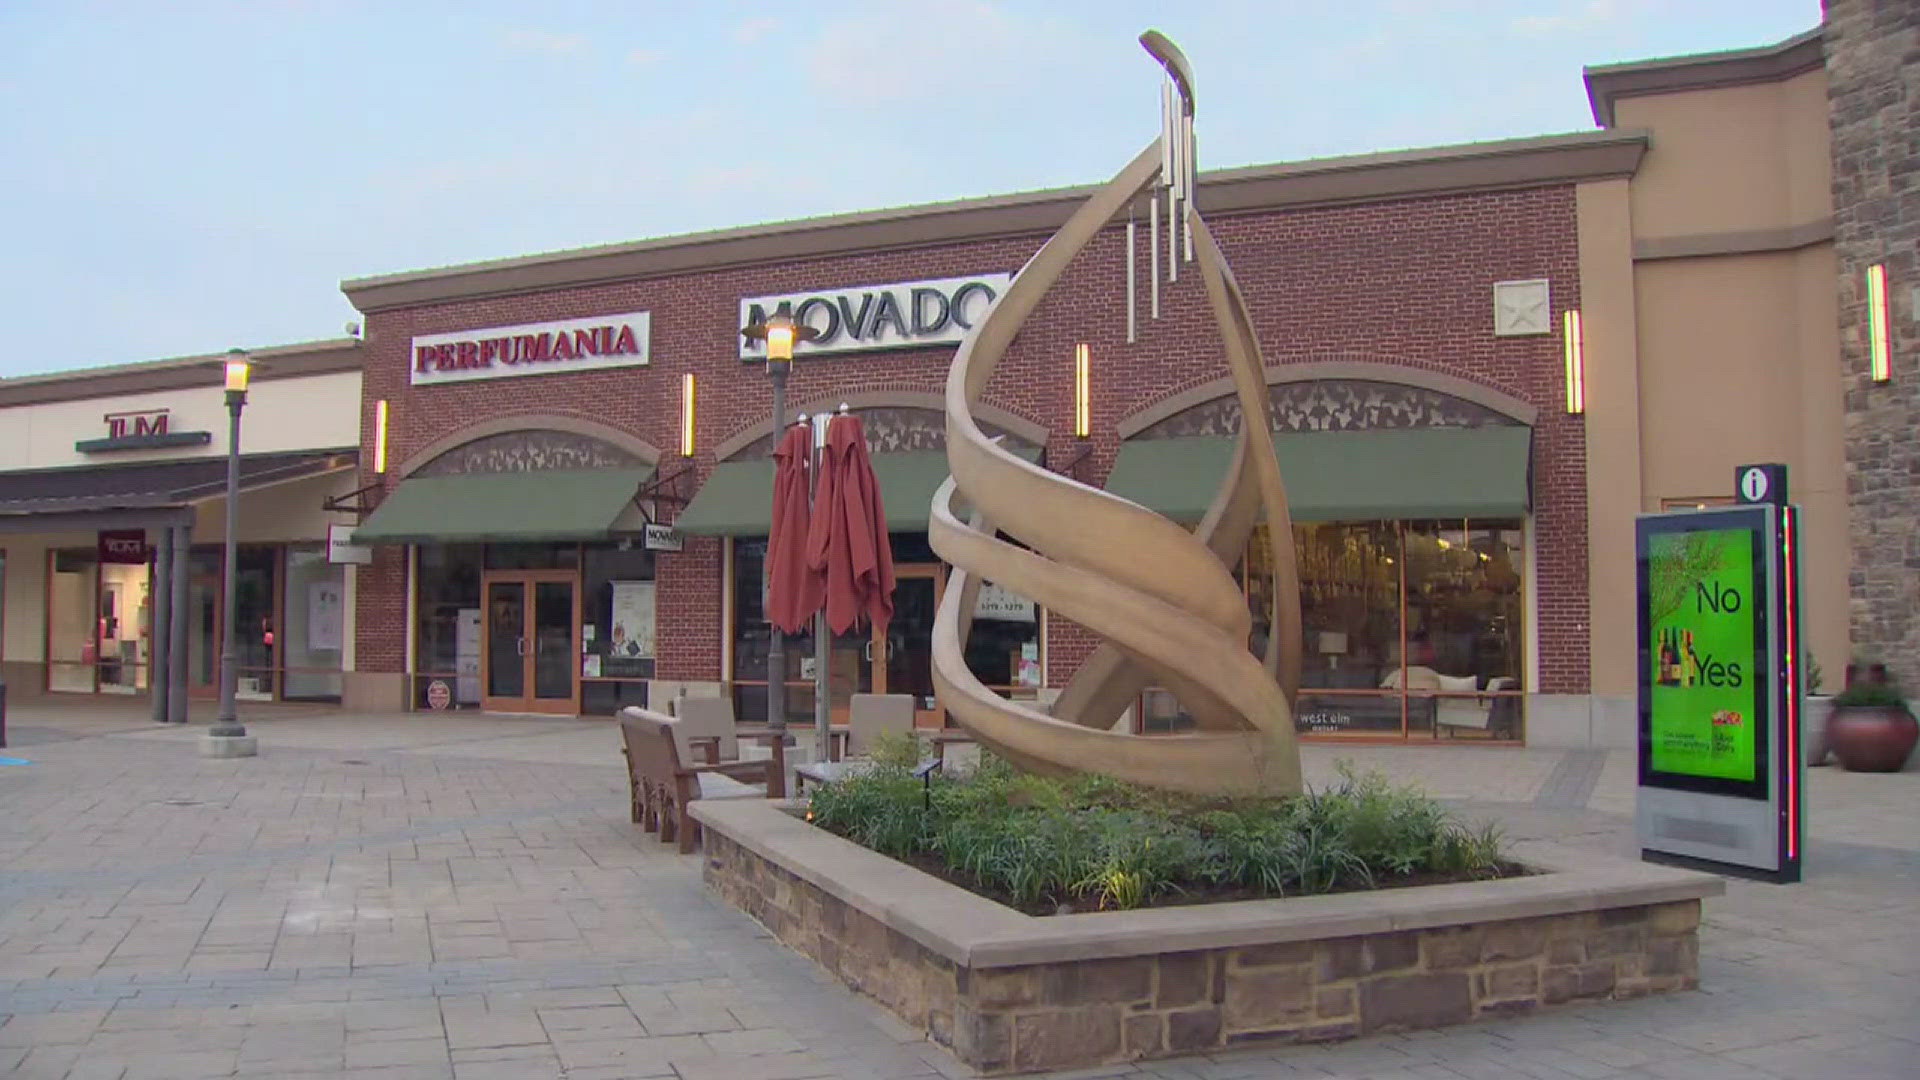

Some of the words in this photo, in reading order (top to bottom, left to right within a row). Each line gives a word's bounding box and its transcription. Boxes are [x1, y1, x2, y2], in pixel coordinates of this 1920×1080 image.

[415, 324, 640, 374] PERFUMANIA
[1697, 581, 1741, 613] No
[1692, 653, 1742, 687] Yes
[1300, 713, 1327, 724] west
[1330, 712, 1350, 725] elm
